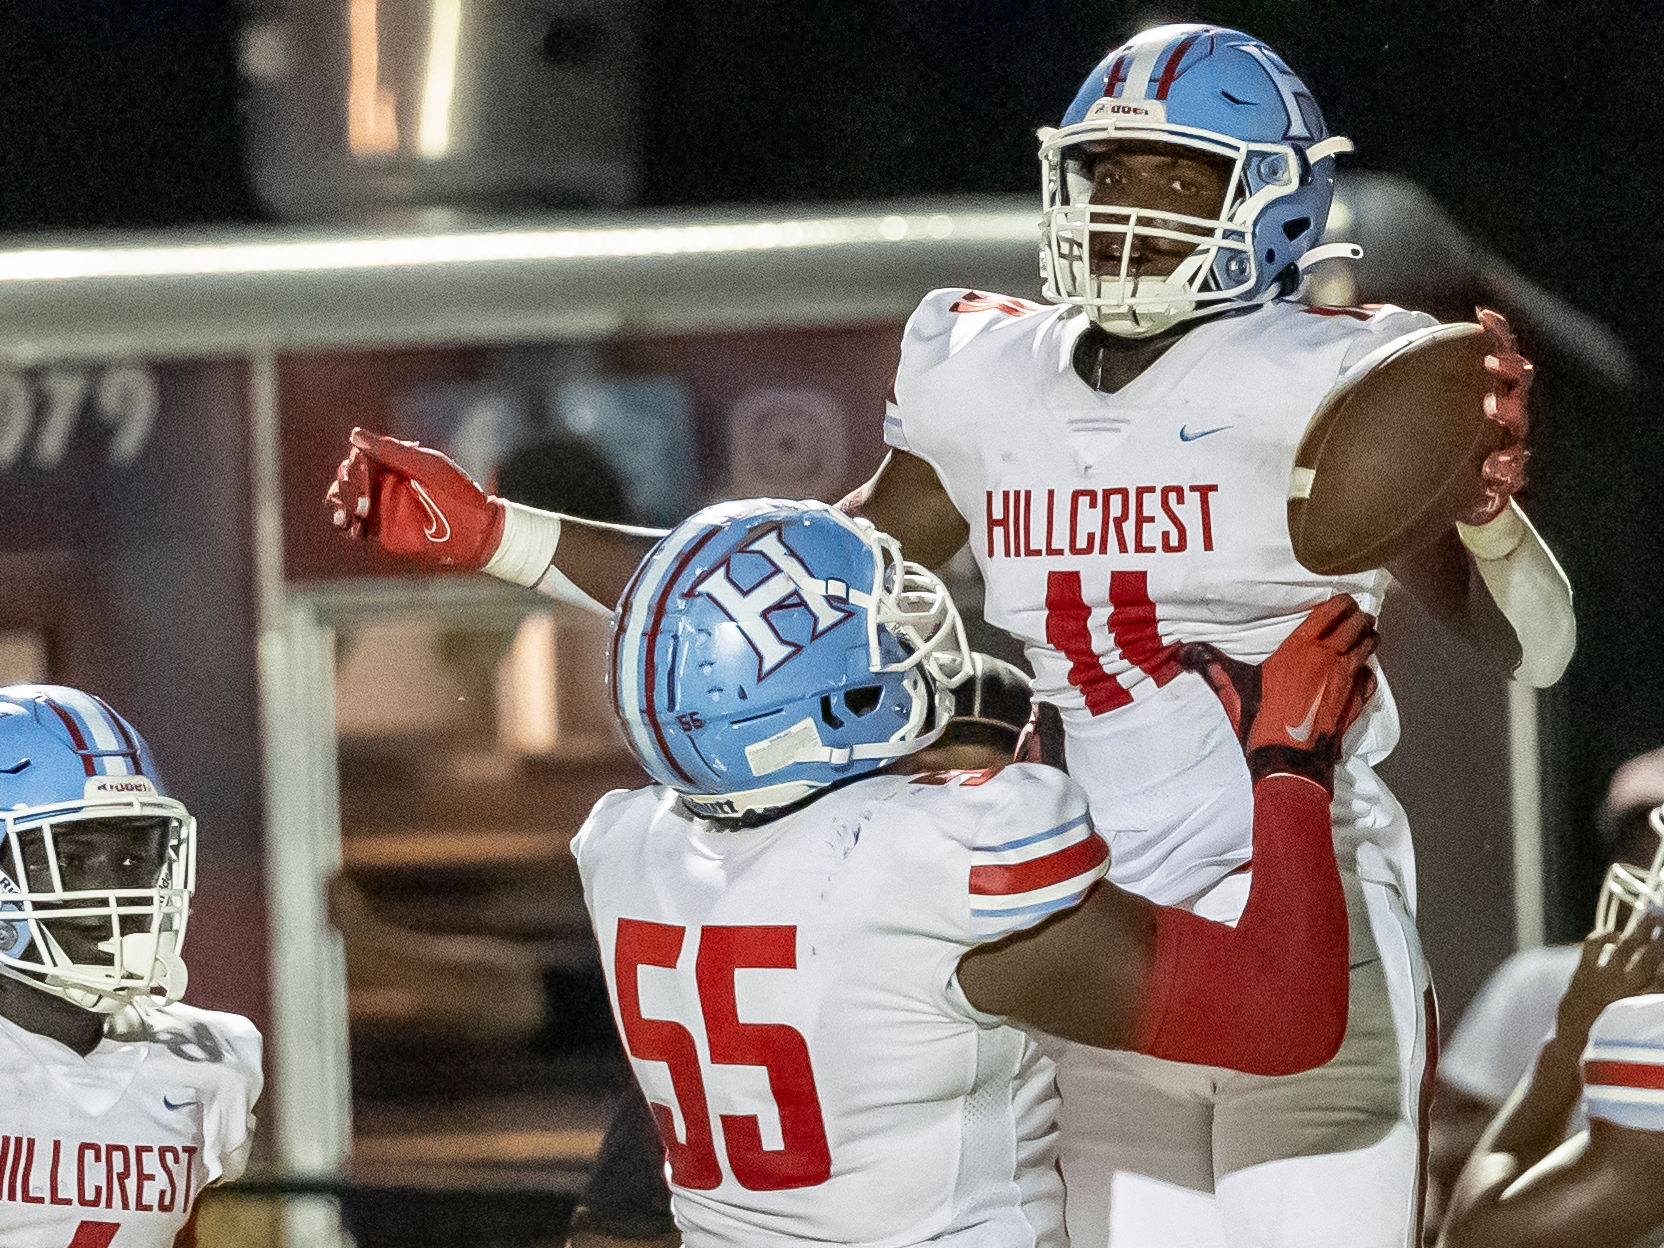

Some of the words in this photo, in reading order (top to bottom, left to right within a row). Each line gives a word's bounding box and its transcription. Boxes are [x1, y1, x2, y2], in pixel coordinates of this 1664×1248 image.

[986, 484, 1219, 558] HILLCREST
[681, 524, 854, 683] H
[1045, 570, 1185, 717] 11
[676, 711, 705, 731] 55
[615, 917, 832, 1191] 55
